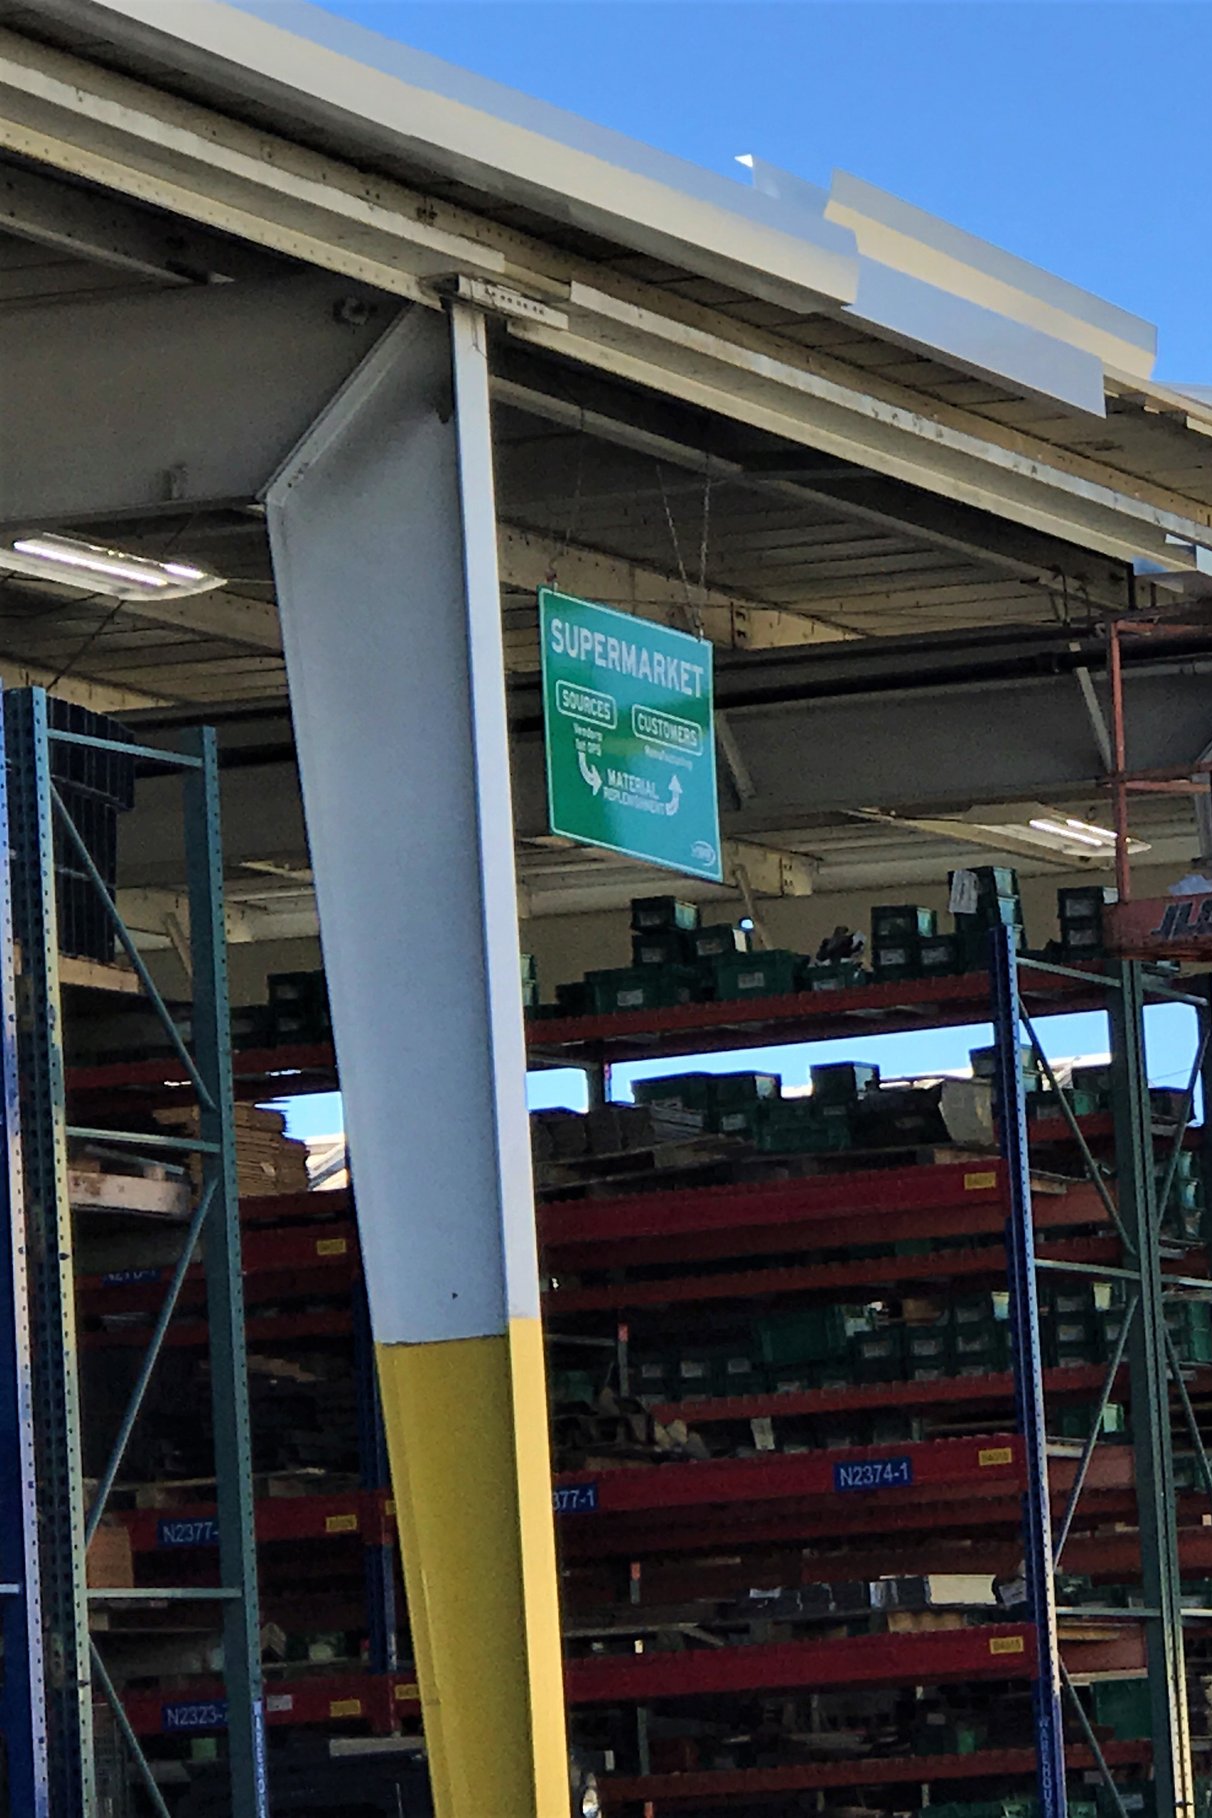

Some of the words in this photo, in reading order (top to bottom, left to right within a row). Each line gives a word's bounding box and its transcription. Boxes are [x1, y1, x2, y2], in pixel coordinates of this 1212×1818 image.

[551, 618, 704, 698] SUPERMARKET
[562, 689, 612, 721] SOURCES
[637, 713, 698, 747] CUSTOMERS
[607, 768, 659, 800] MATERIAL
[603, 786, 666, 815] REPLENISHMENT
[839, 1462, 908, 1487] N2374-1
[163, 1521, 219, 1543] N2377-
